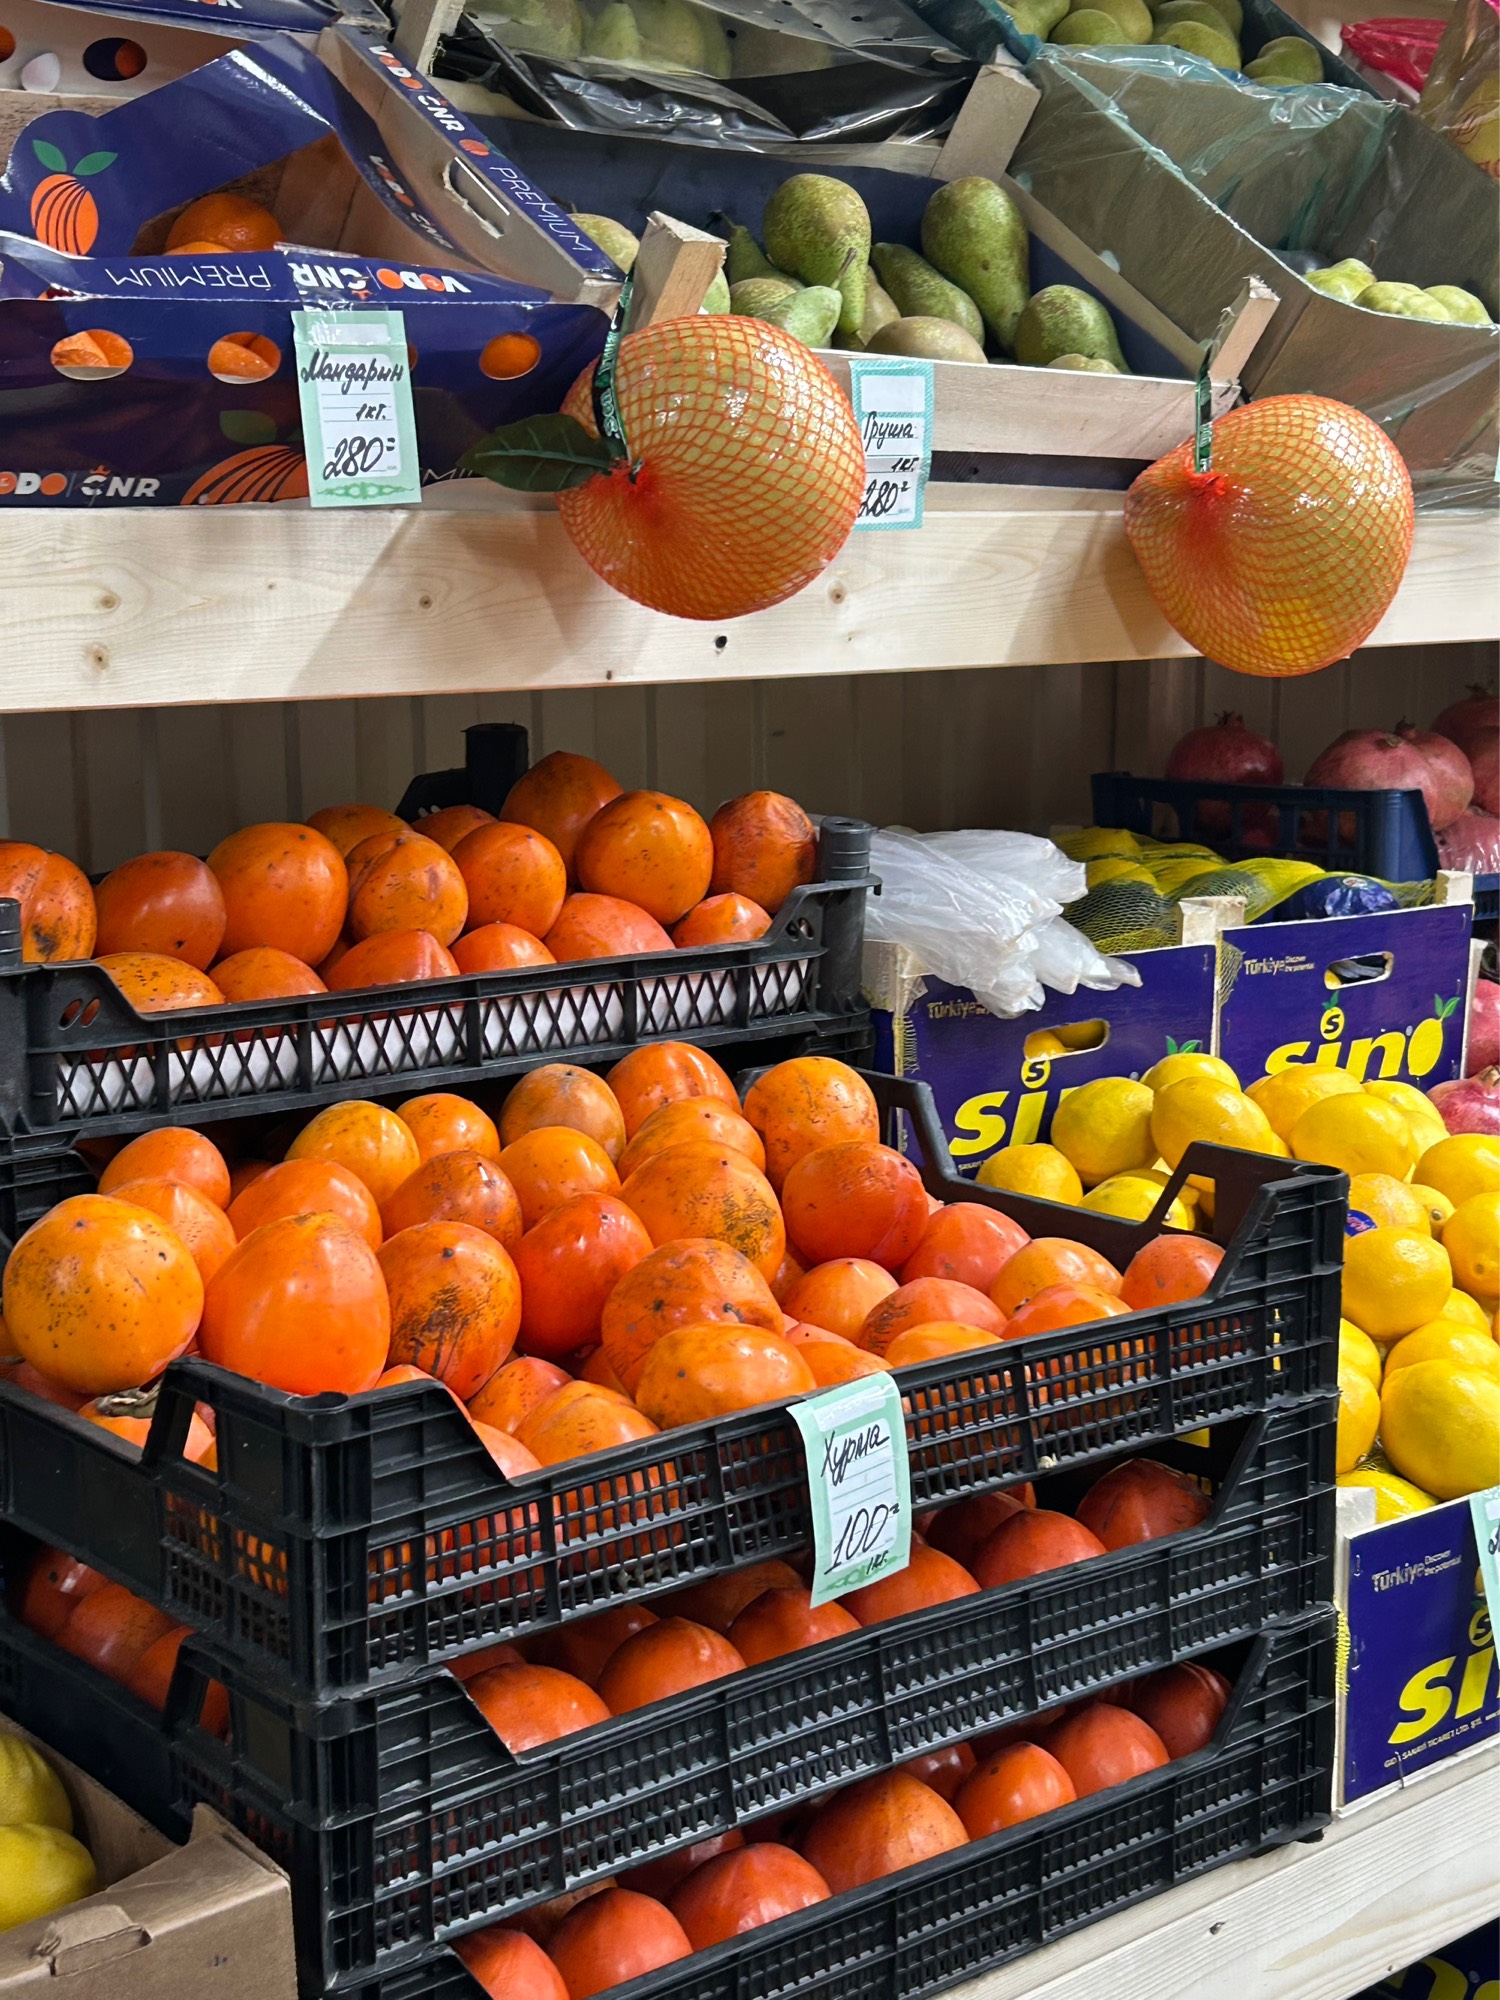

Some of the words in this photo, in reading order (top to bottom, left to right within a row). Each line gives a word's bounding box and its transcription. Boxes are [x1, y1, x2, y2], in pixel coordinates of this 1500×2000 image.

[369, 46, 423, 90] VODO
[417, 95, 465, 132] CNR
[490, 166, 593, 252] PREMIUM
[105, 265, 271, 288] PREMIUM
[377, 268, 471, 293] VODO
[301, 349, 404, 395] Мандарин
[863, 411, 917, 452] Груша
[0, 471, 67, 495] ODO
[81, 474, 160, 497] CNR
[1244, 957, 1285, 976] Türkiye
[927, 999, 977, 1019] Türkiye
[949, 1086, 1079, 1156] si
[821, 1424, 890, 1486] Хурма
[1371, 1562, 1425, 1592] Türkiye
[1388, 1645, 1500, 1744] si
